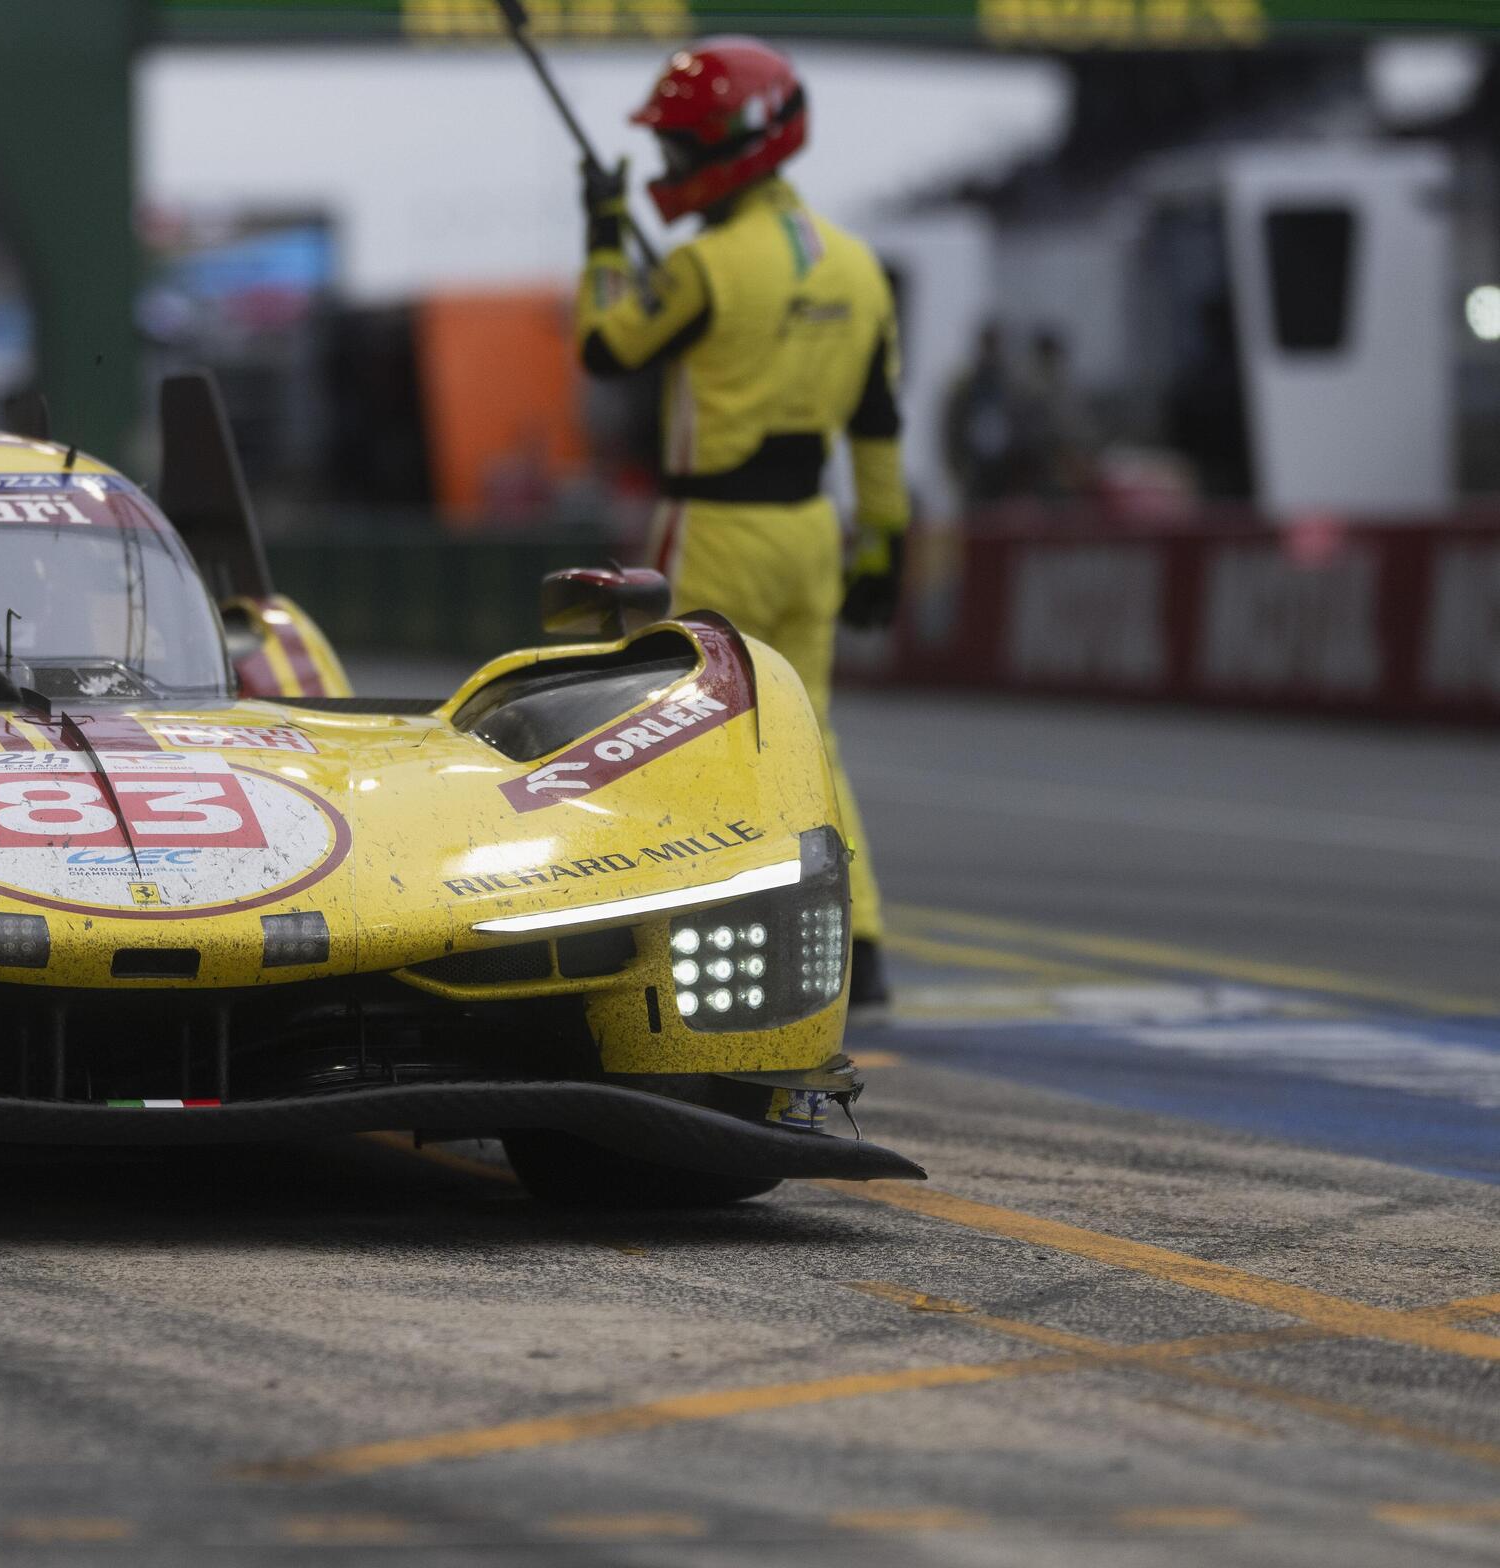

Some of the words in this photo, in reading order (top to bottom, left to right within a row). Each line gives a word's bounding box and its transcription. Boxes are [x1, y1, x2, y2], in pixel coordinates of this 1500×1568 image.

[175, 733, 305, 750] CAR
[594, 690, 728, 762] ORLEN
[66, 848, 203, 865] WEC
[442, 852, 638, 897] RICHARD
[638, 819, 765, 865] MILLE
